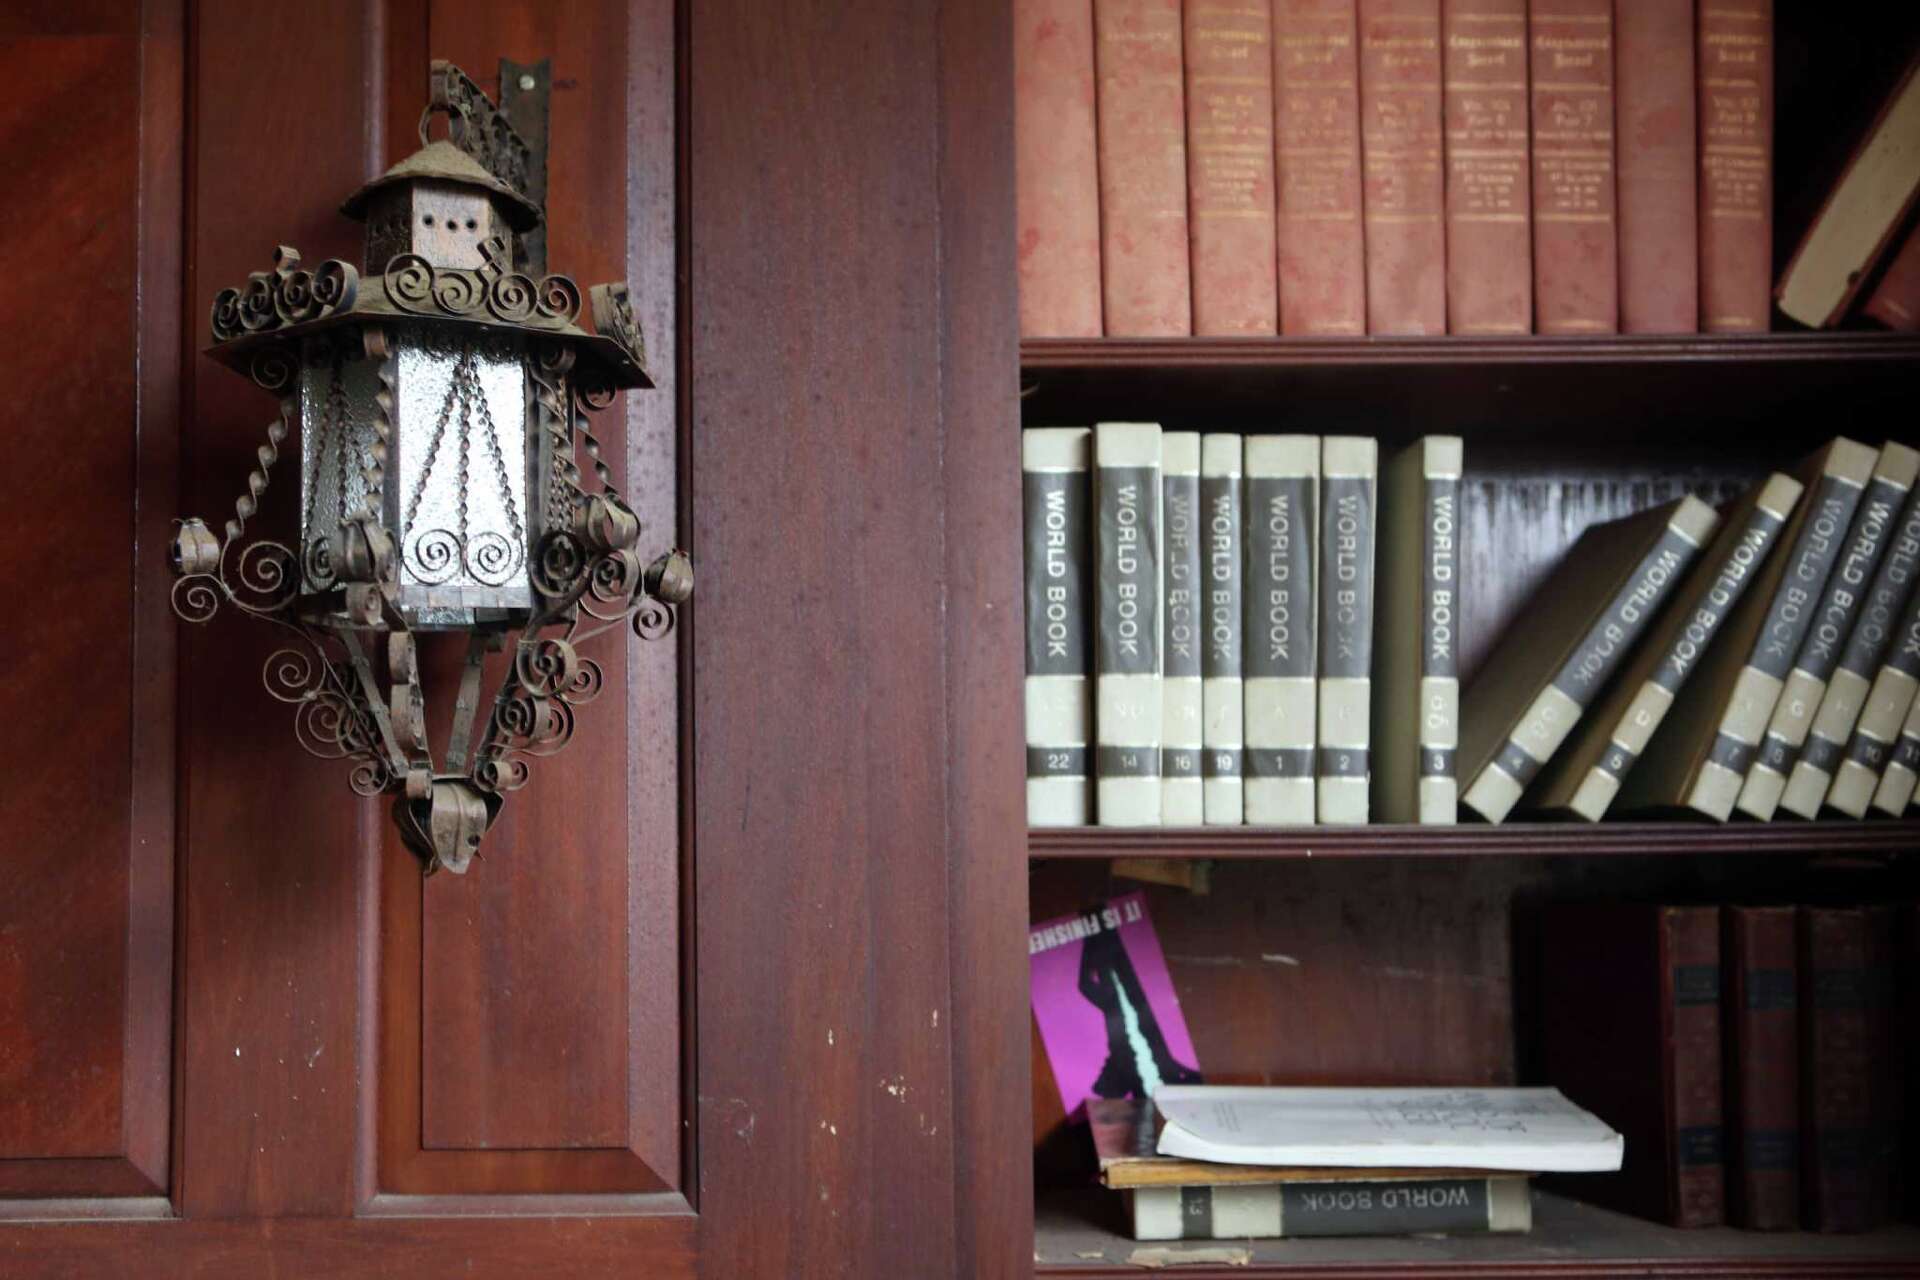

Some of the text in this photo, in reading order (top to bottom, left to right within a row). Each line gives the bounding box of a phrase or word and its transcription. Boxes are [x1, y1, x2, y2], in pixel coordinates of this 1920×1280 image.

[1338, 494, 1357, 581] WORLD
[1796, 499, 1843, 582] WORLD
[1843, 501, 1891, 586] WORLD
[1046, 489, 1067, 657] WORLD BOOK
[1117, 484, 1138, 656] WORLD BOOK
[1212, 494, 1232, 660] WORLD BOOK
[1270, 494, 1289, 660] WORLD BOOK
[1432, 495, 1452, 660] WORLD BOOK
[1620, 549, 1681, 625] WORLD
[1669, 527, 1768, 676] WORLD BOOK
[1047, 753, 1070, 770] 22
[1121, 754, 1138, 769] 14
[1174, 755, 1191, 770] 16
[1216, 755, 1233, 771] 19
[1275, 755, 1284, 771] 1
[1339, 755, 1351, 771] 2
[1433, 755, 1445, 771] 3
[1102, 907, 1122, 930] IS
[1125, 900, 1142, 922] IT
[1301, 1186, 1469, 1212] WORLD BOOK
